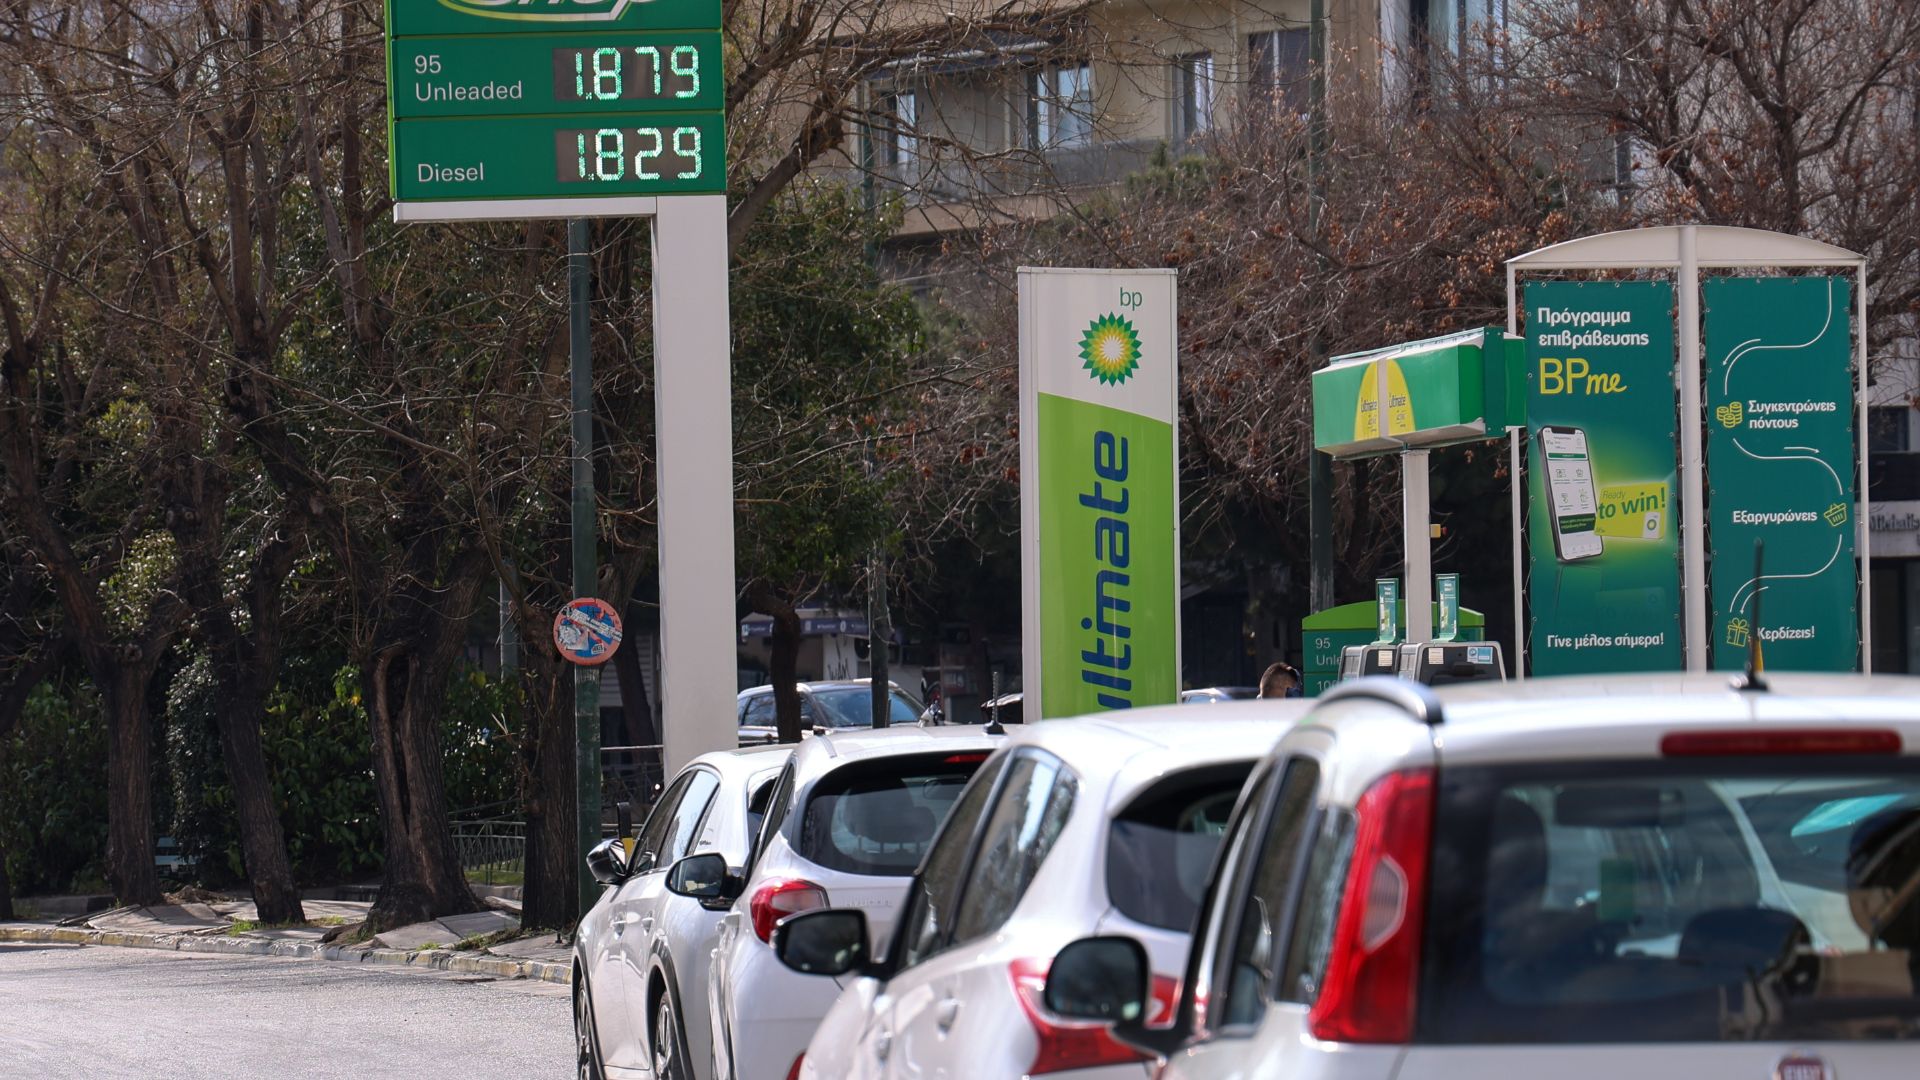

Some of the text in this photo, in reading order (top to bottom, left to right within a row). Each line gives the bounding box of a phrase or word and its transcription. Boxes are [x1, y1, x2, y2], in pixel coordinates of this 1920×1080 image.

[414, 45, 700, 100] 95 1.879
[414, 80, 522, 101] Unleaded
[417, 126, 702, 182] Diesel 1.829
[1119, 286, 1143, 312] bp
[1537, 307, 1631, 327] Πρόγραμμα
[1538, 329, 1650, 350] επιβράβευσης
[1748, 399, 1837, 415] Συγκεντρώνεις
[1749, 416, 1799, 429] πόντους
[1599, 486, 1666, 520] to win!
[1733, 504, 1818, 525] Εξαργυρώνεις
[1315, 637, 1331, 649] 95
[1547, 632, 1665, 649] Γίνε μέλος σήμερα!
[1757, 625, 1815, 642] Κερδίζεις!
